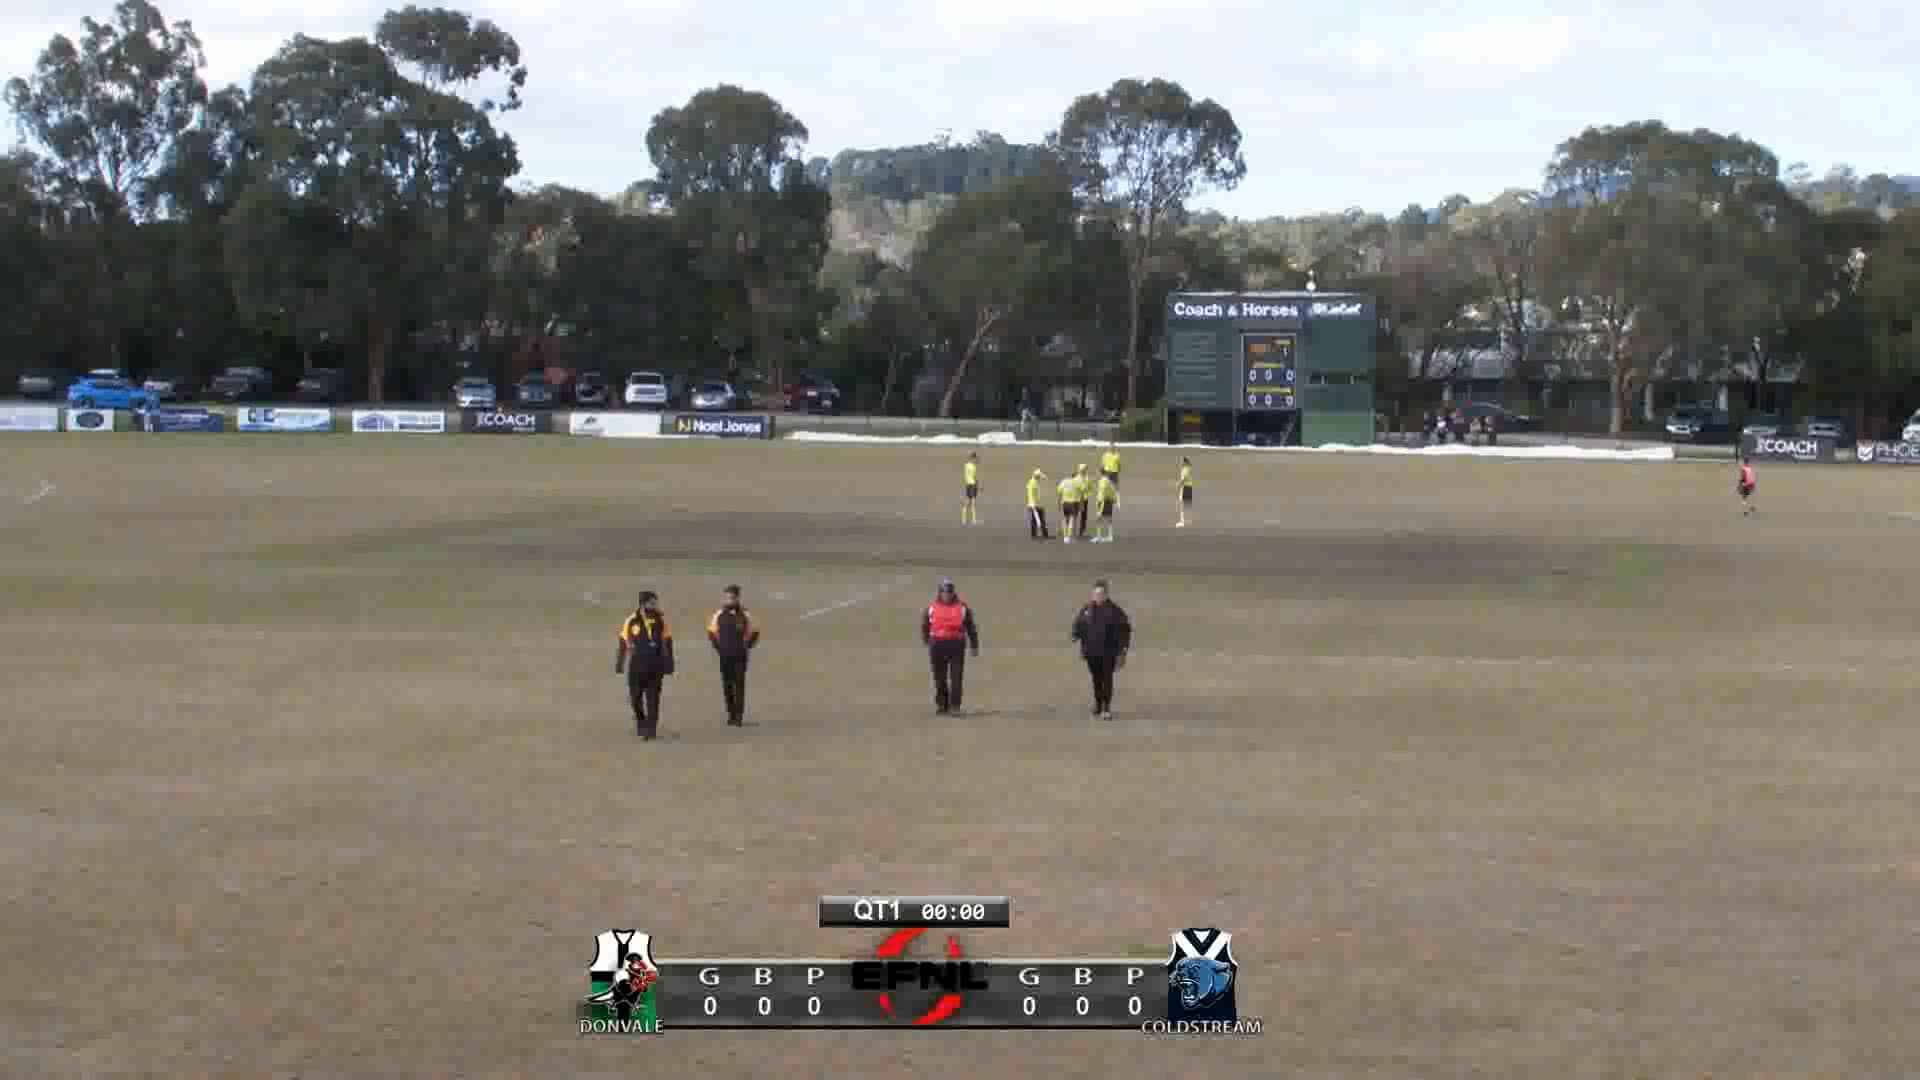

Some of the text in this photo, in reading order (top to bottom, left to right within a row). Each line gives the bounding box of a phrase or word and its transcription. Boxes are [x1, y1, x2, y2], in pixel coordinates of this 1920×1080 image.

[1174, 302, 1223, 316] Coach
[1227, 304, 1238, 315] &
[1242, 303, 1298, 317] Horses
[693, 419, 723, 432] Noel
[724, 419, 761, 433] Jones
[1765, 439, 1817, 453] COACH
